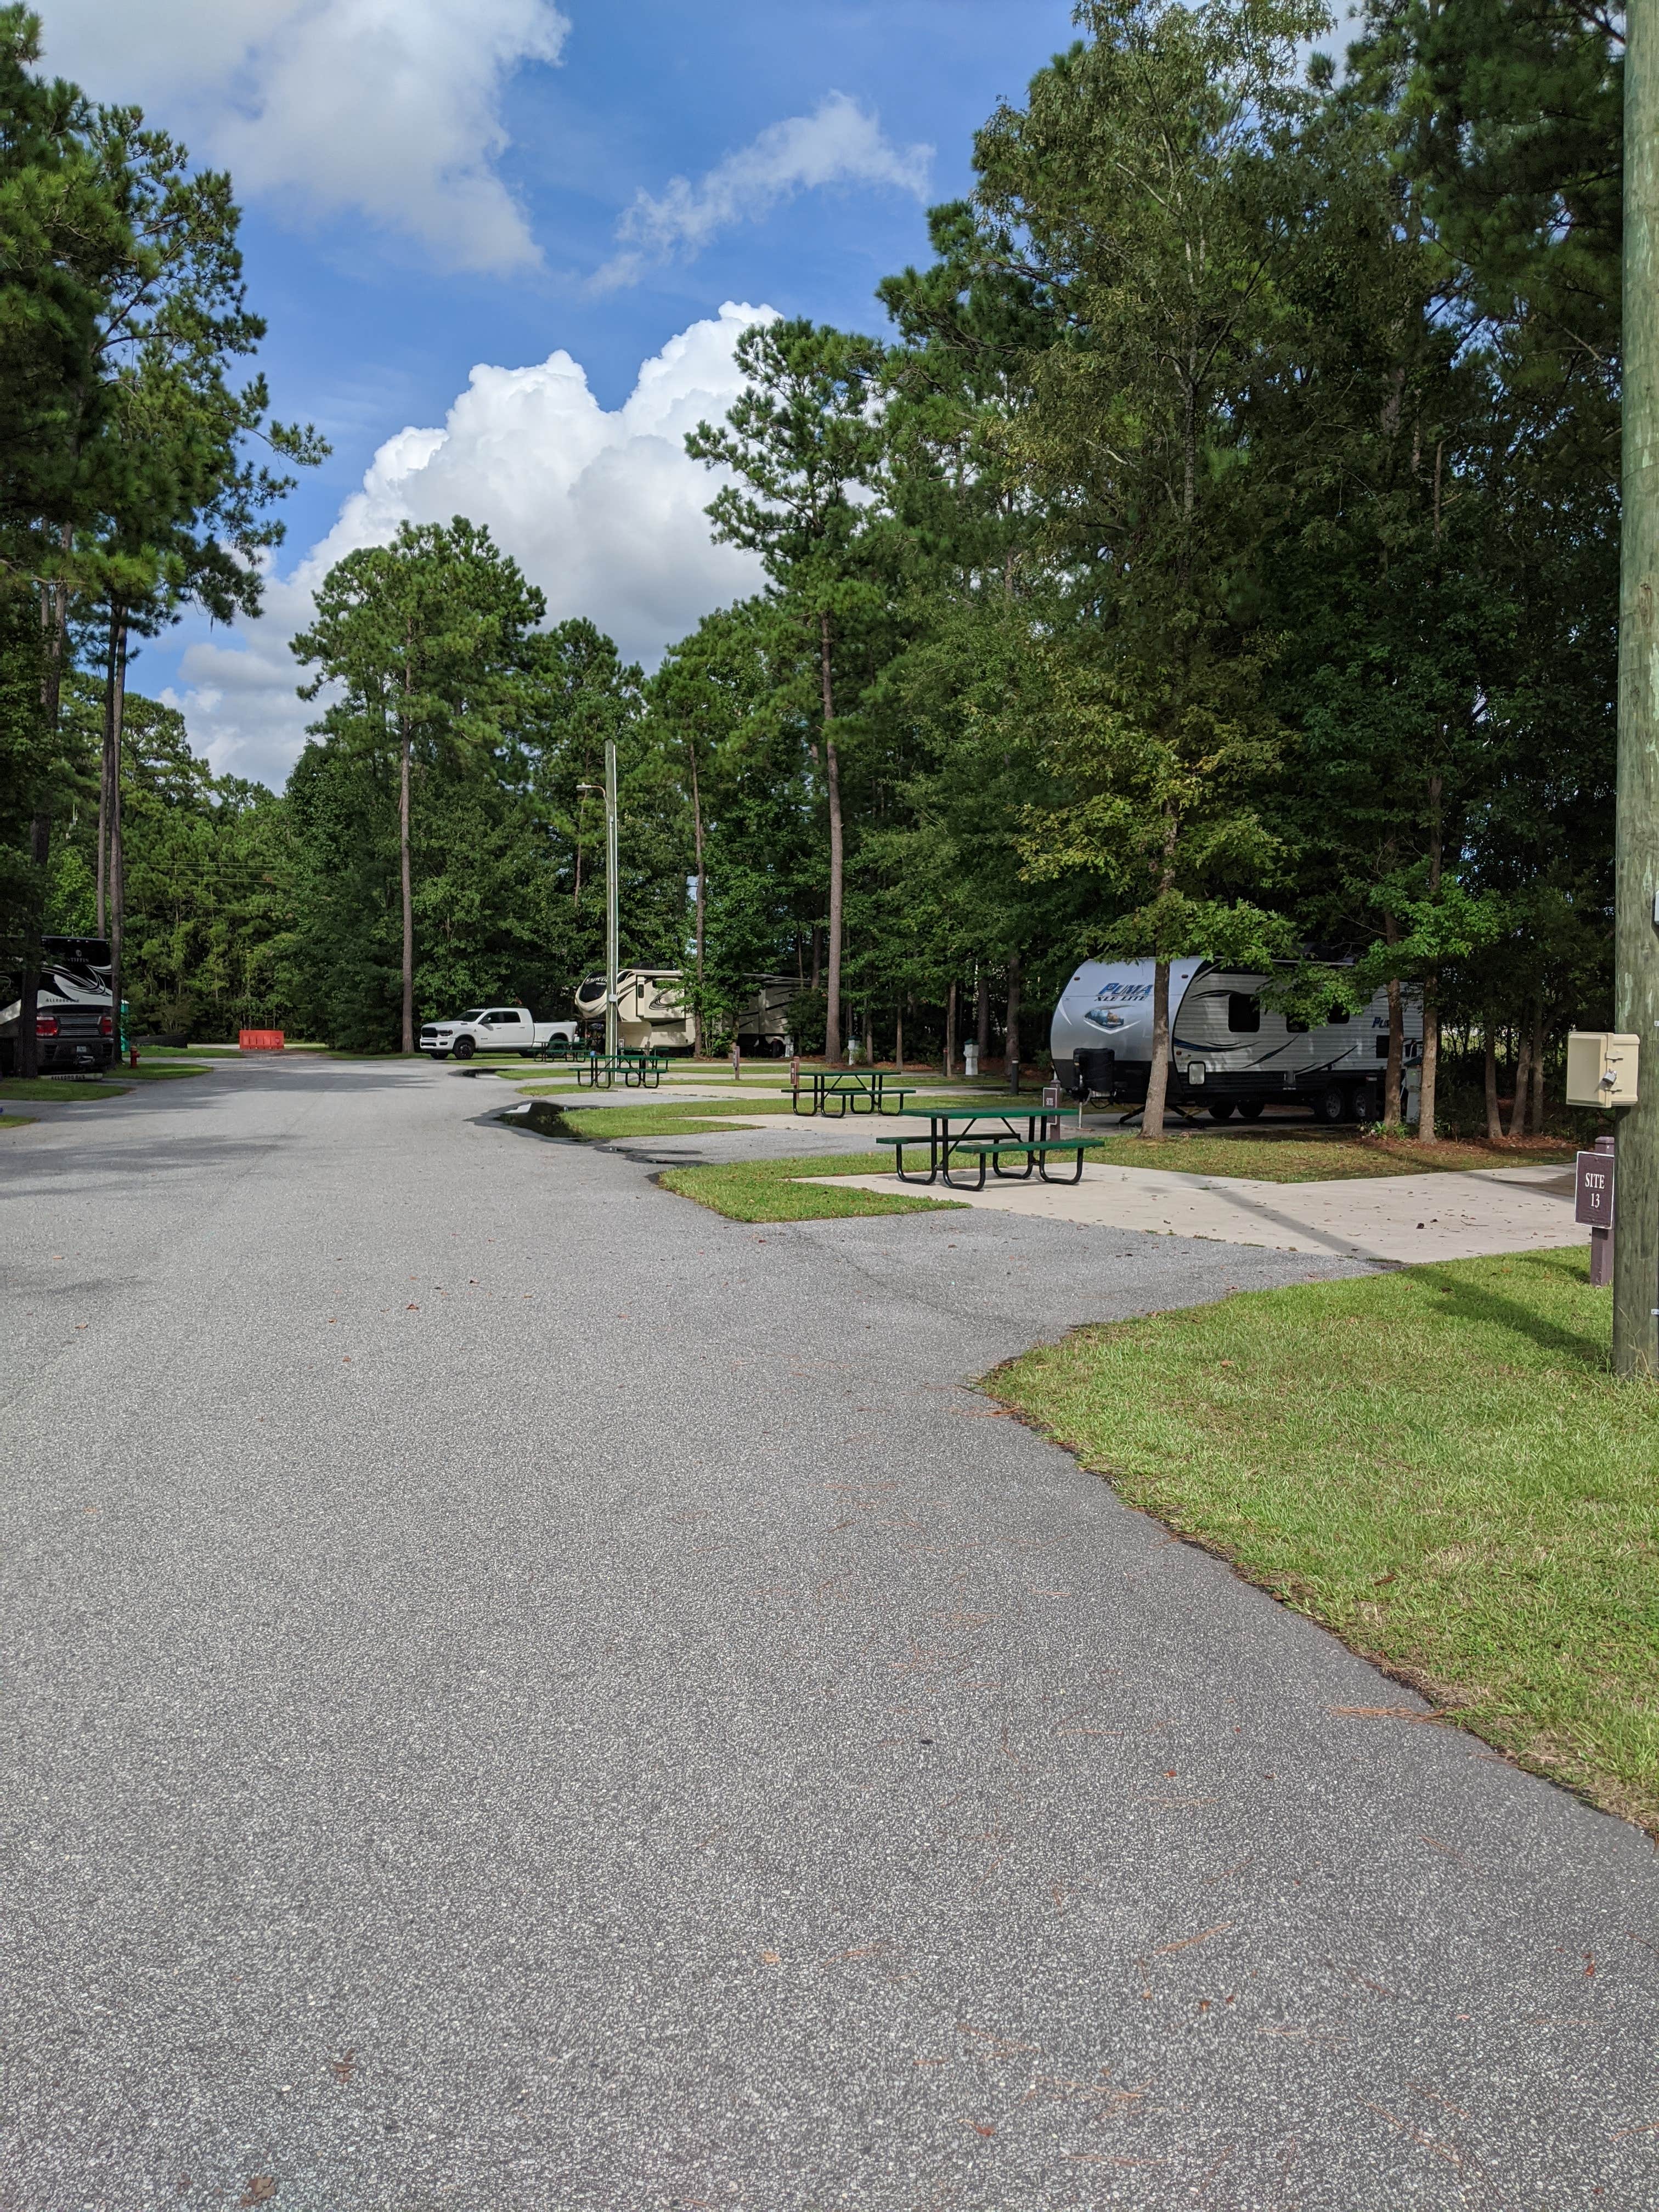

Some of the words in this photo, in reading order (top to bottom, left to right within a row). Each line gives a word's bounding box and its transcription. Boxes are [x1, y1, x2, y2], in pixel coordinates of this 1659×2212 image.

[1098, 983, 1153, 995] PUMA
[1584, 1172, 1605, 1189] SITE
[1591, 1193, 1600, 1208] 13
